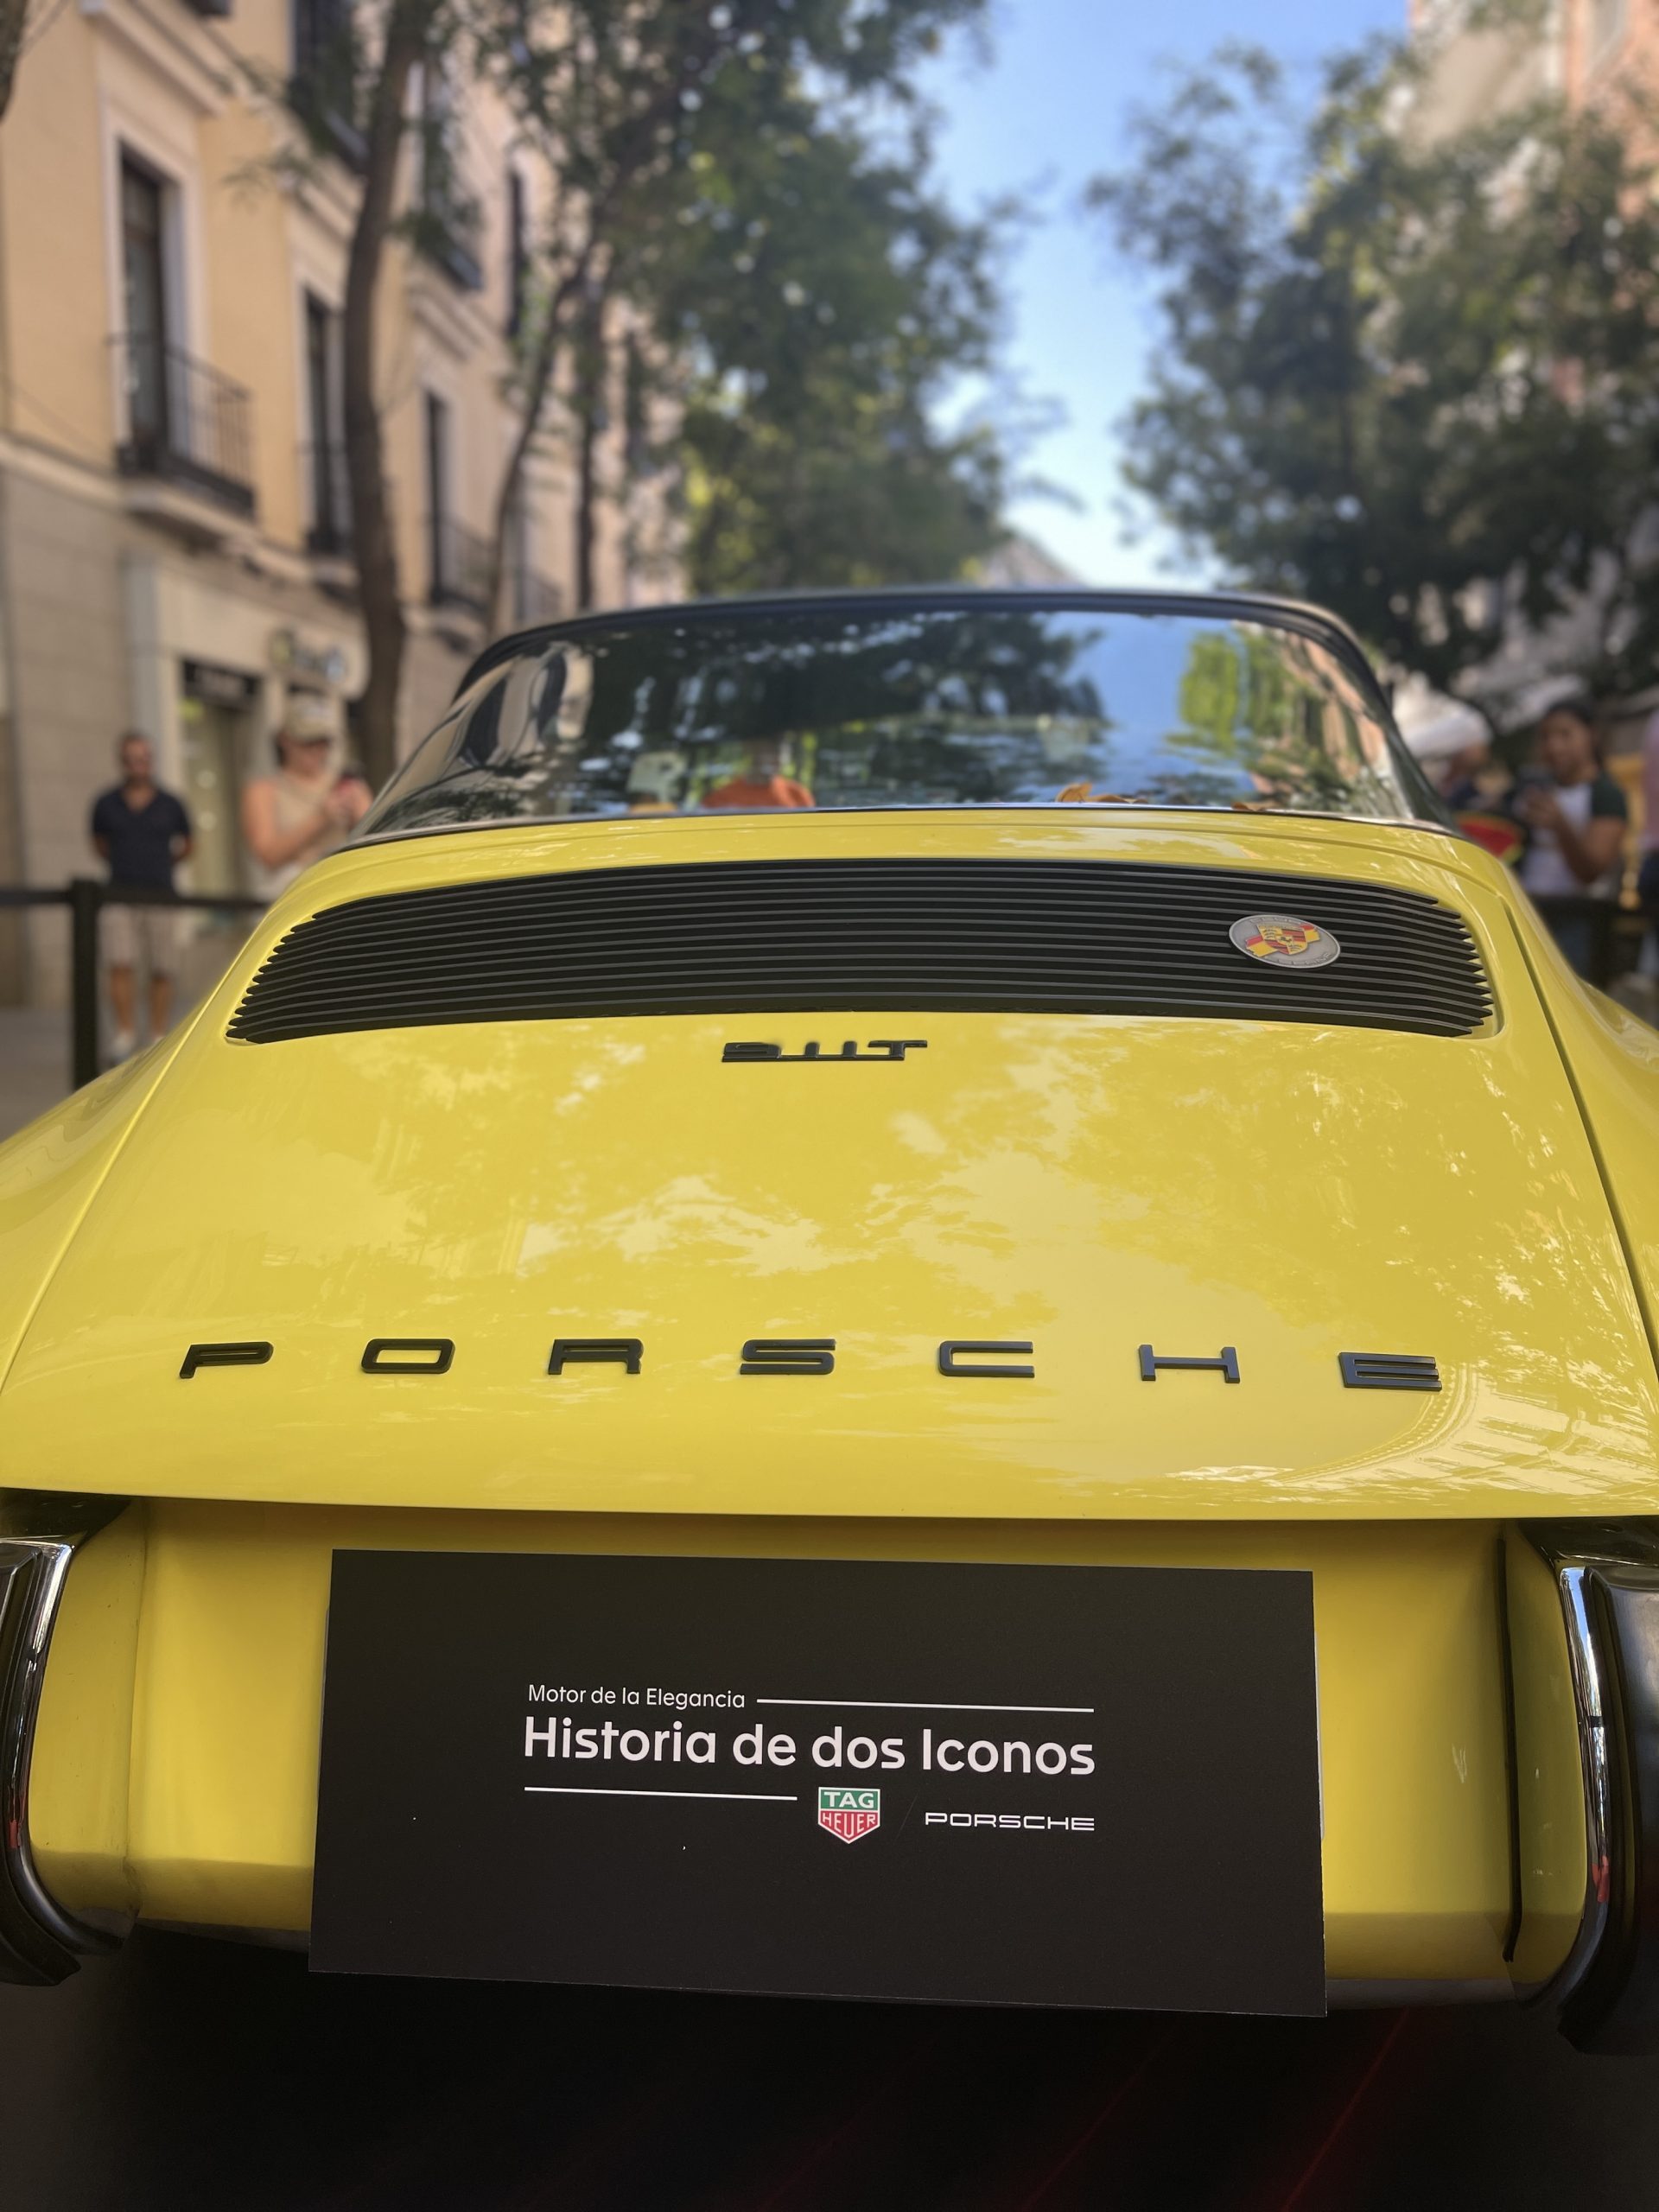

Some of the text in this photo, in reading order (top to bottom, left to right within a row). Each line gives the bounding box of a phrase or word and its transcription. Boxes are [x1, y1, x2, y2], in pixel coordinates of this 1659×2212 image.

[179, 1338, 1442, 1392] PORSCHE
[528, 1684, 745, 1711] Motor de la Elegancia
[524, 1716, 1096, 1776] Historia de dos Iconos
[822, 1790, 876, 1809] TAG
[822, 1812, 876, 1839] HEUER
[925, 1812, 1095, 1832] PORSCHE
